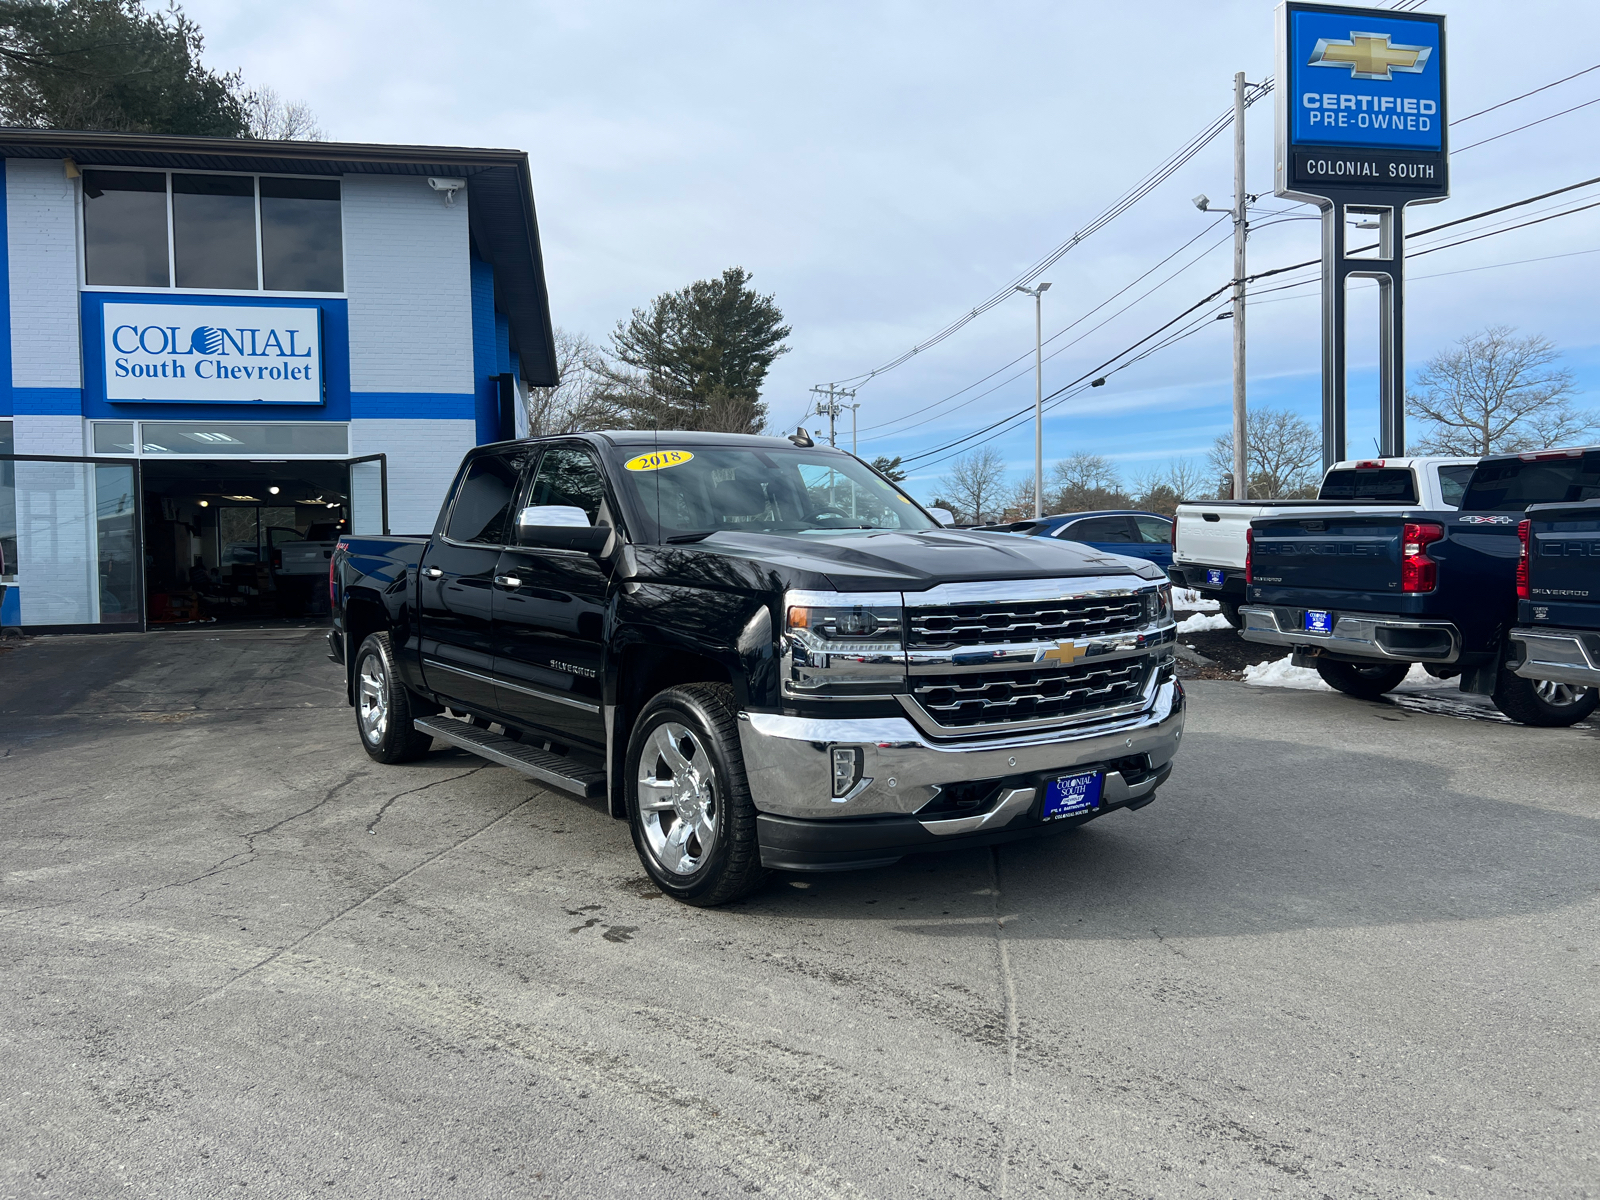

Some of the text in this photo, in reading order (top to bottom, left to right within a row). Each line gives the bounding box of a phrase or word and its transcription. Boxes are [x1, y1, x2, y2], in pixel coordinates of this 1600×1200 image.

[1303, 92, 1437, 115] CERTIFIED
[1310, 111, 1431, 131] PRE-OWNED
[1307, 159, 1434, 179] COLONIAL SOUTH
[112, 325, 312, 357] COLONIAL
[115, 358, 312, 381] South Chevrolet
[639, 451, 682, 469] 2018
[1255, 543, 1387, 556] CHEVROLET
[1532, 588, 1589, 597] SILVERADO
[550, 659, 596, 678] SILVERADO
[1057, 776, 1092, 789] COLONIAL
[1061, 785, 1086, 796] SOUTH
